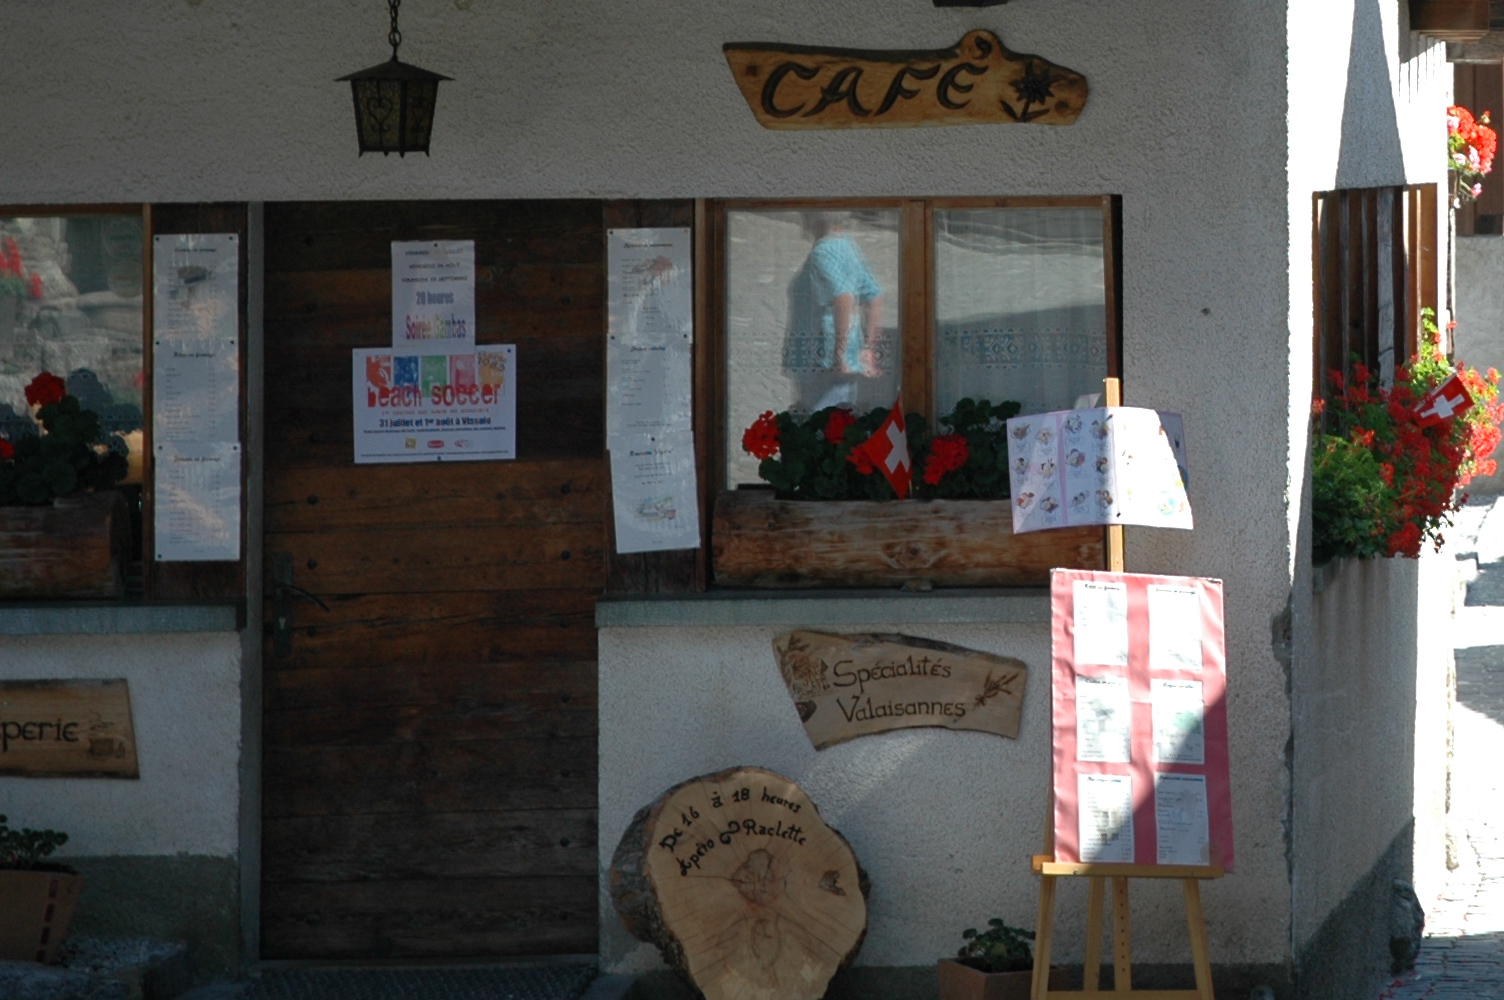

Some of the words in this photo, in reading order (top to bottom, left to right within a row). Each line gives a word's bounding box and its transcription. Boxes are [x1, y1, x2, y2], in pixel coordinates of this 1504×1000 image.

[367, 382, 422, 408] beach
[431, 382, 503, 408] soccer
[832, 654, 952, 695] Spécialités
[836, 695, 967, 724] Valaisannes
[0, 718, 79, 752] perie
[659, 827, 683, 853] De
[681, 806, 700, 827] 16
[711, 791, 723, 808] à
[732, 787, 750, 803] 18
[761, 786, 802, 814] heures
[742, 818, 807, 847] Raclette
